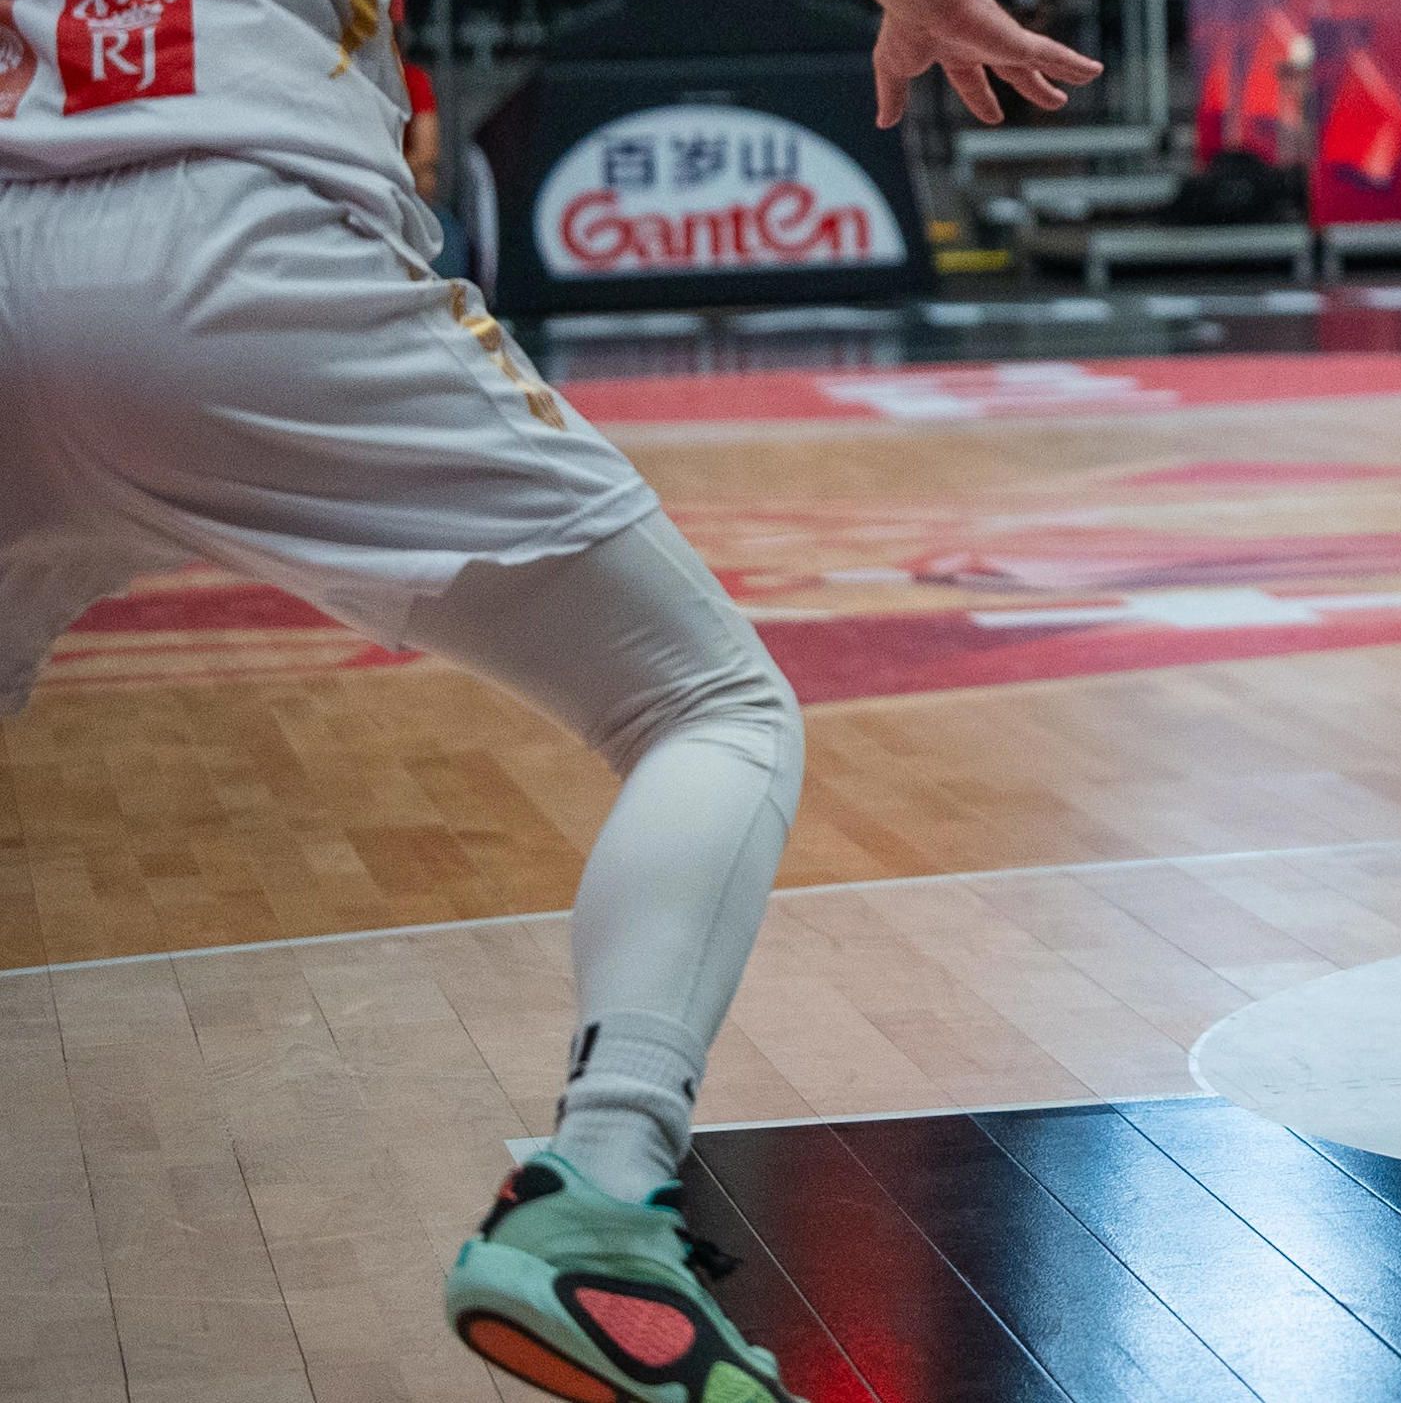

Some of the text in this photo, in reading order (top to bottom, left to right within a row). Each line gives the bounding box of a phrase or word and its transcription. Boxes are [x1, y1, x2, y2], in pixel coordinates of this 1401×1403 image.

[91, 28, 158, 91] RJ
[604, 133, 800, 191] 百岁山
